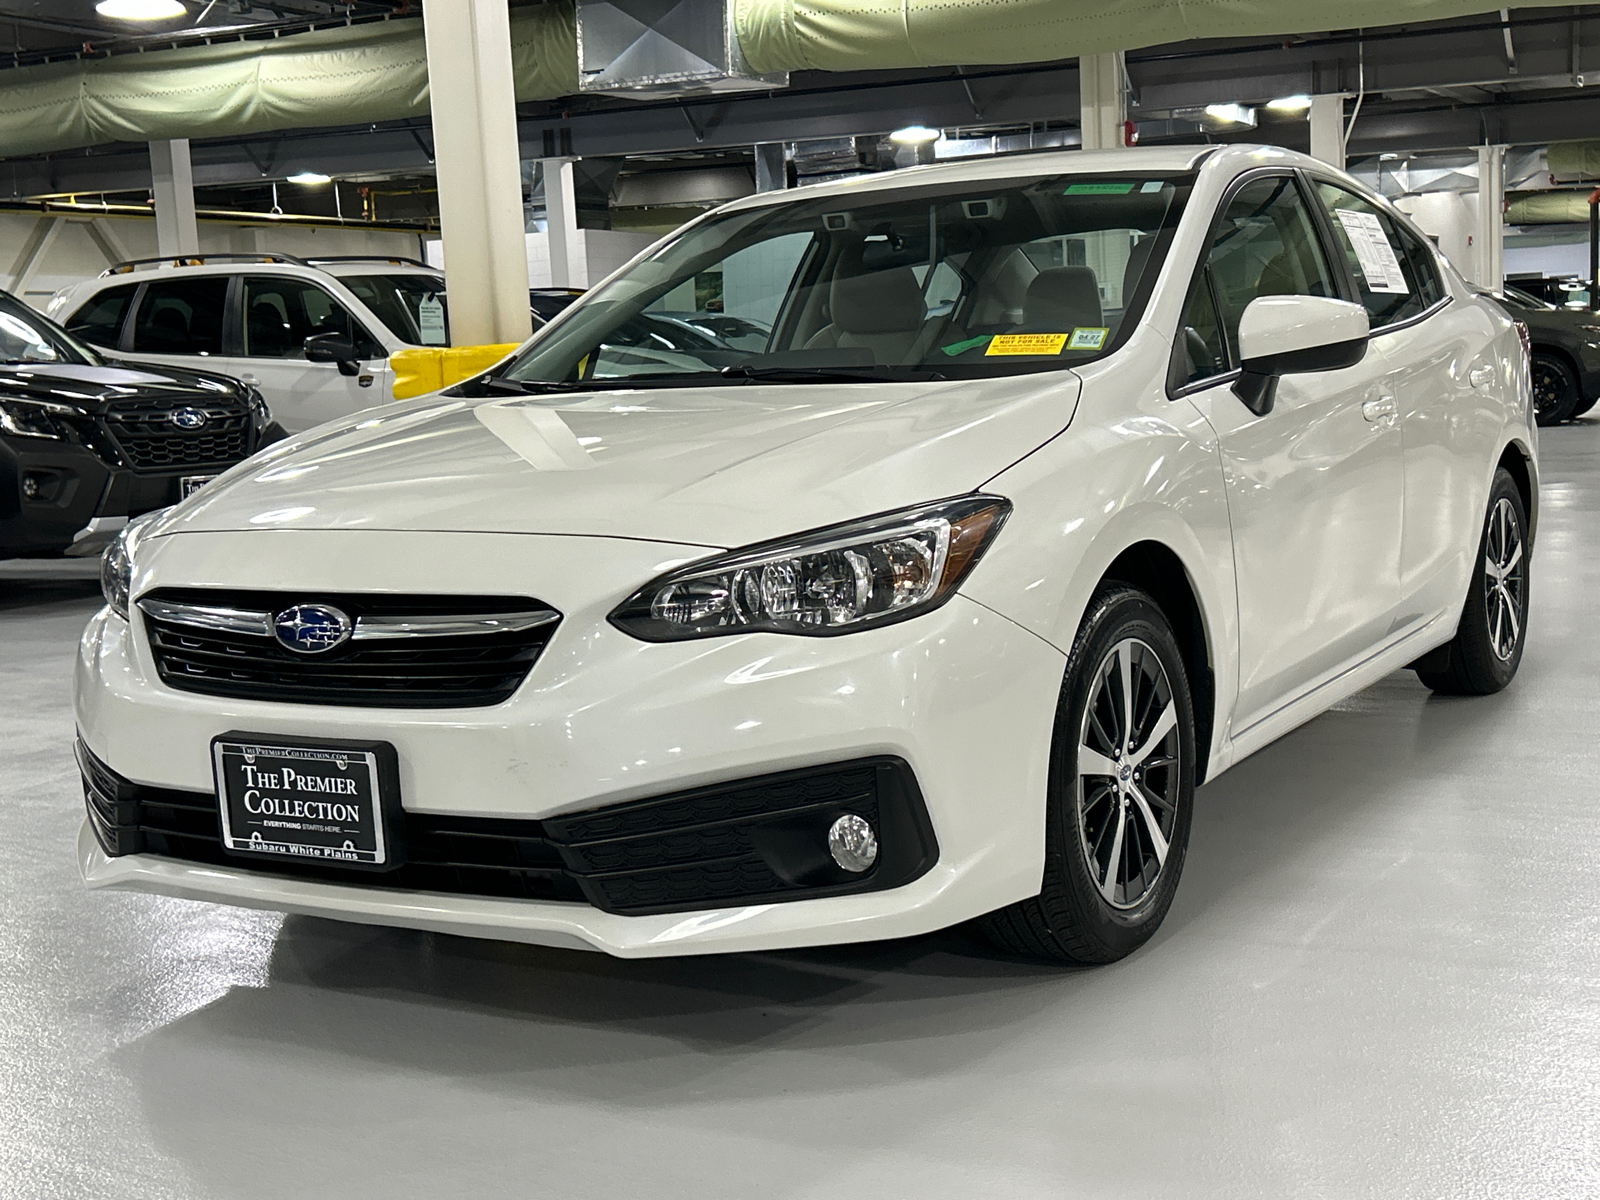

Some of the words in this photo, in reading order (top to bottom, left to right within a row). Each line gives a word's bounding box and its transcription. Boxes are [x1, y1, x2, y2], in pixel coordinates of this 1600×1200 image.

[241, 765, 280, 789] THE
[281, 767, 358, 795] PREMIER
[244, 790, 360, 822] COLLECTION
[263, 820, 302, 830] EVERYTHING
[302, 824, 324, 832] STARTS
[248, 841, 286, 853] Subaru
[289, 845, 321, 857] White
[324, 849, 358, 860] Plains
